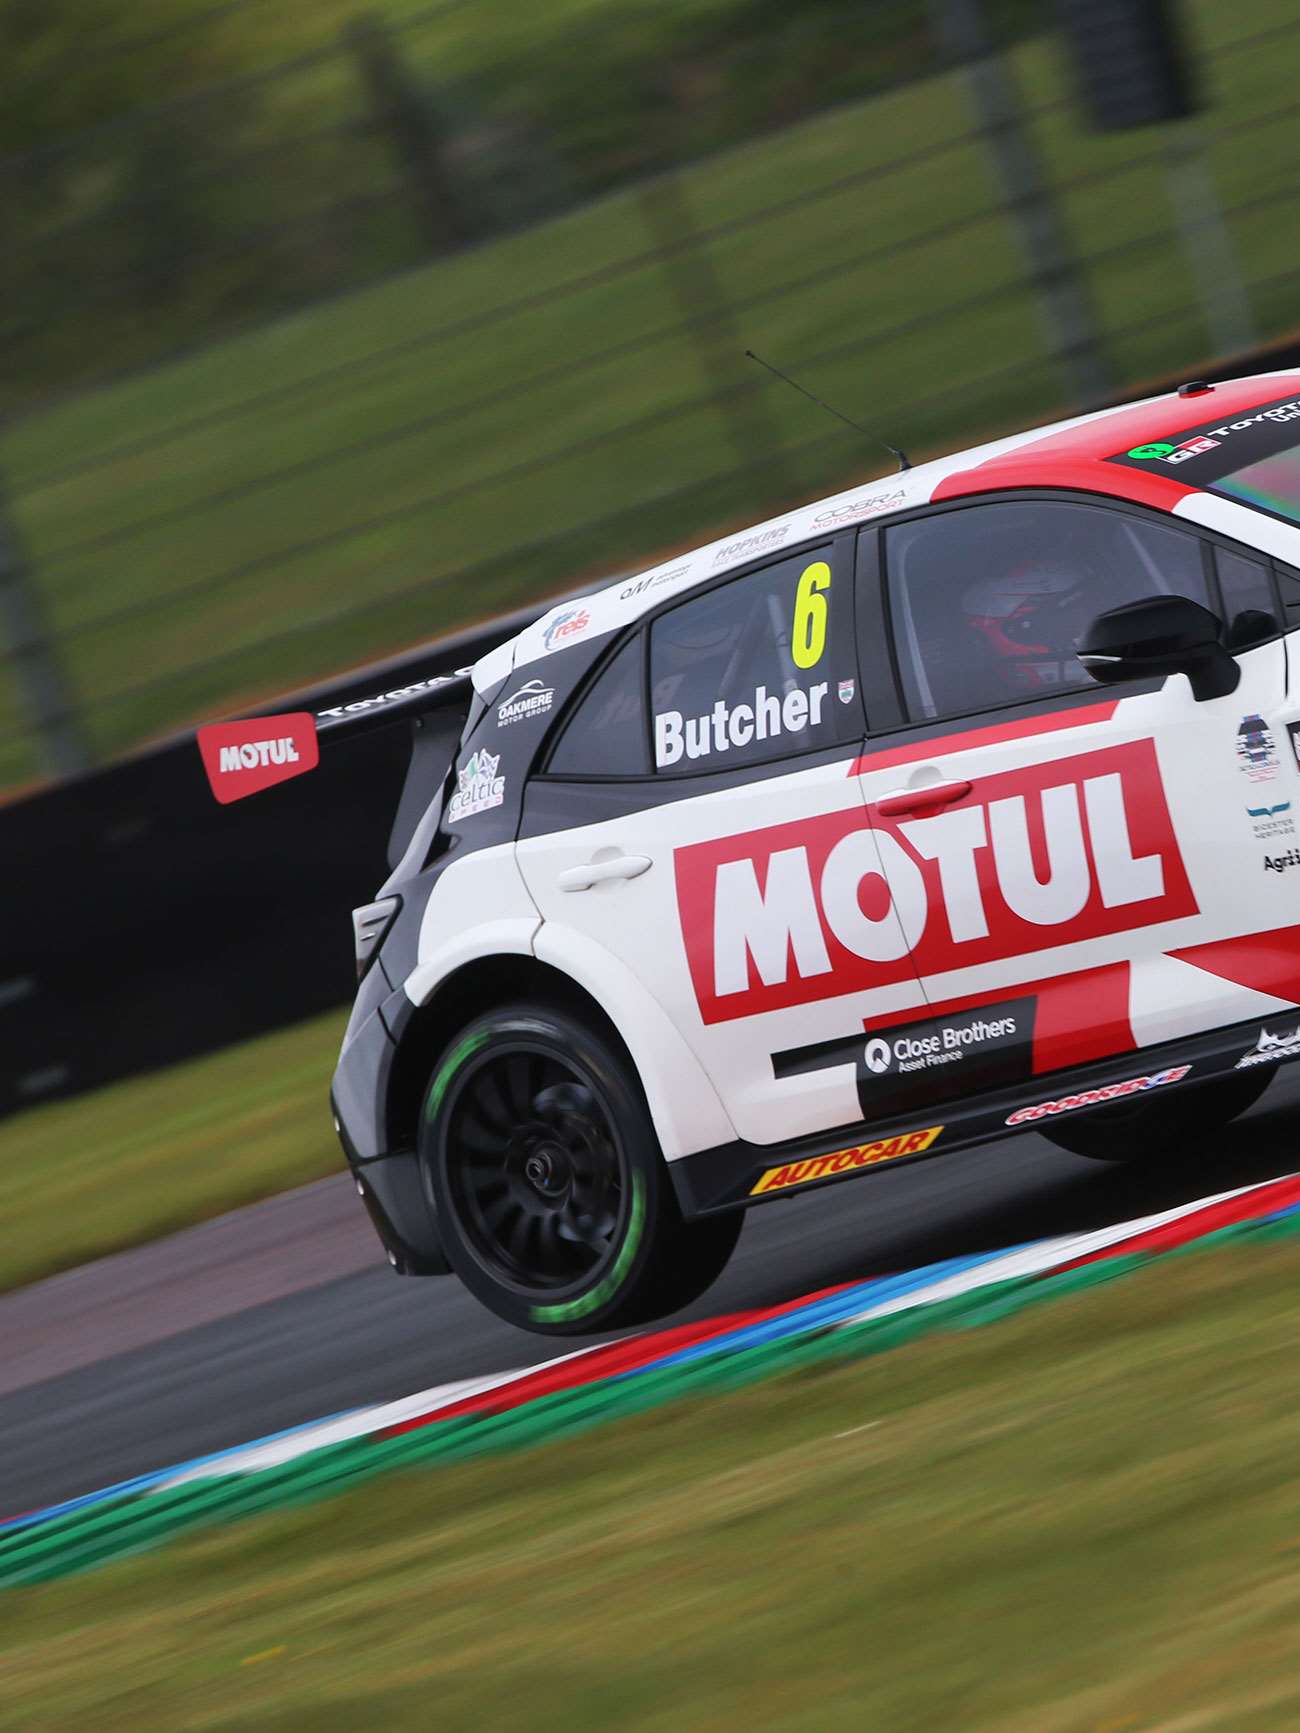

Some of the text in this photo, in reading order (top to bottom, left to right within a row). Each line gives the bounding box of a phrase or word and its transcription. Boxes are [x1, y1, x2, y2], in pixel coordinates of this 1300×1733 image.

[1166, 439, 1218, 462] GR
[809, 500, 903, 531] MOTORSPORT
[814, 489, 906, 522] COBRA
[715, 523, 793, 559] HOPKINS
[791, 562, 831, 669] 6
[317, 676, 453, 718] TOYOTA
[498, 691, 554, 720] OAKMERE
[497, 705, 552, 728] MOTOR GROUP
[655, 679, 829, 768] Butcher
[219, 736, 300, 774] MOTUL
[713, 772, 1166, 997] MOTUL
[894, 1017, 1017, 1060] Close Brothers
[899, 1050, 964, 1074] Asset Finance
[762, 1131, 930, 1190] AUTOCAR
